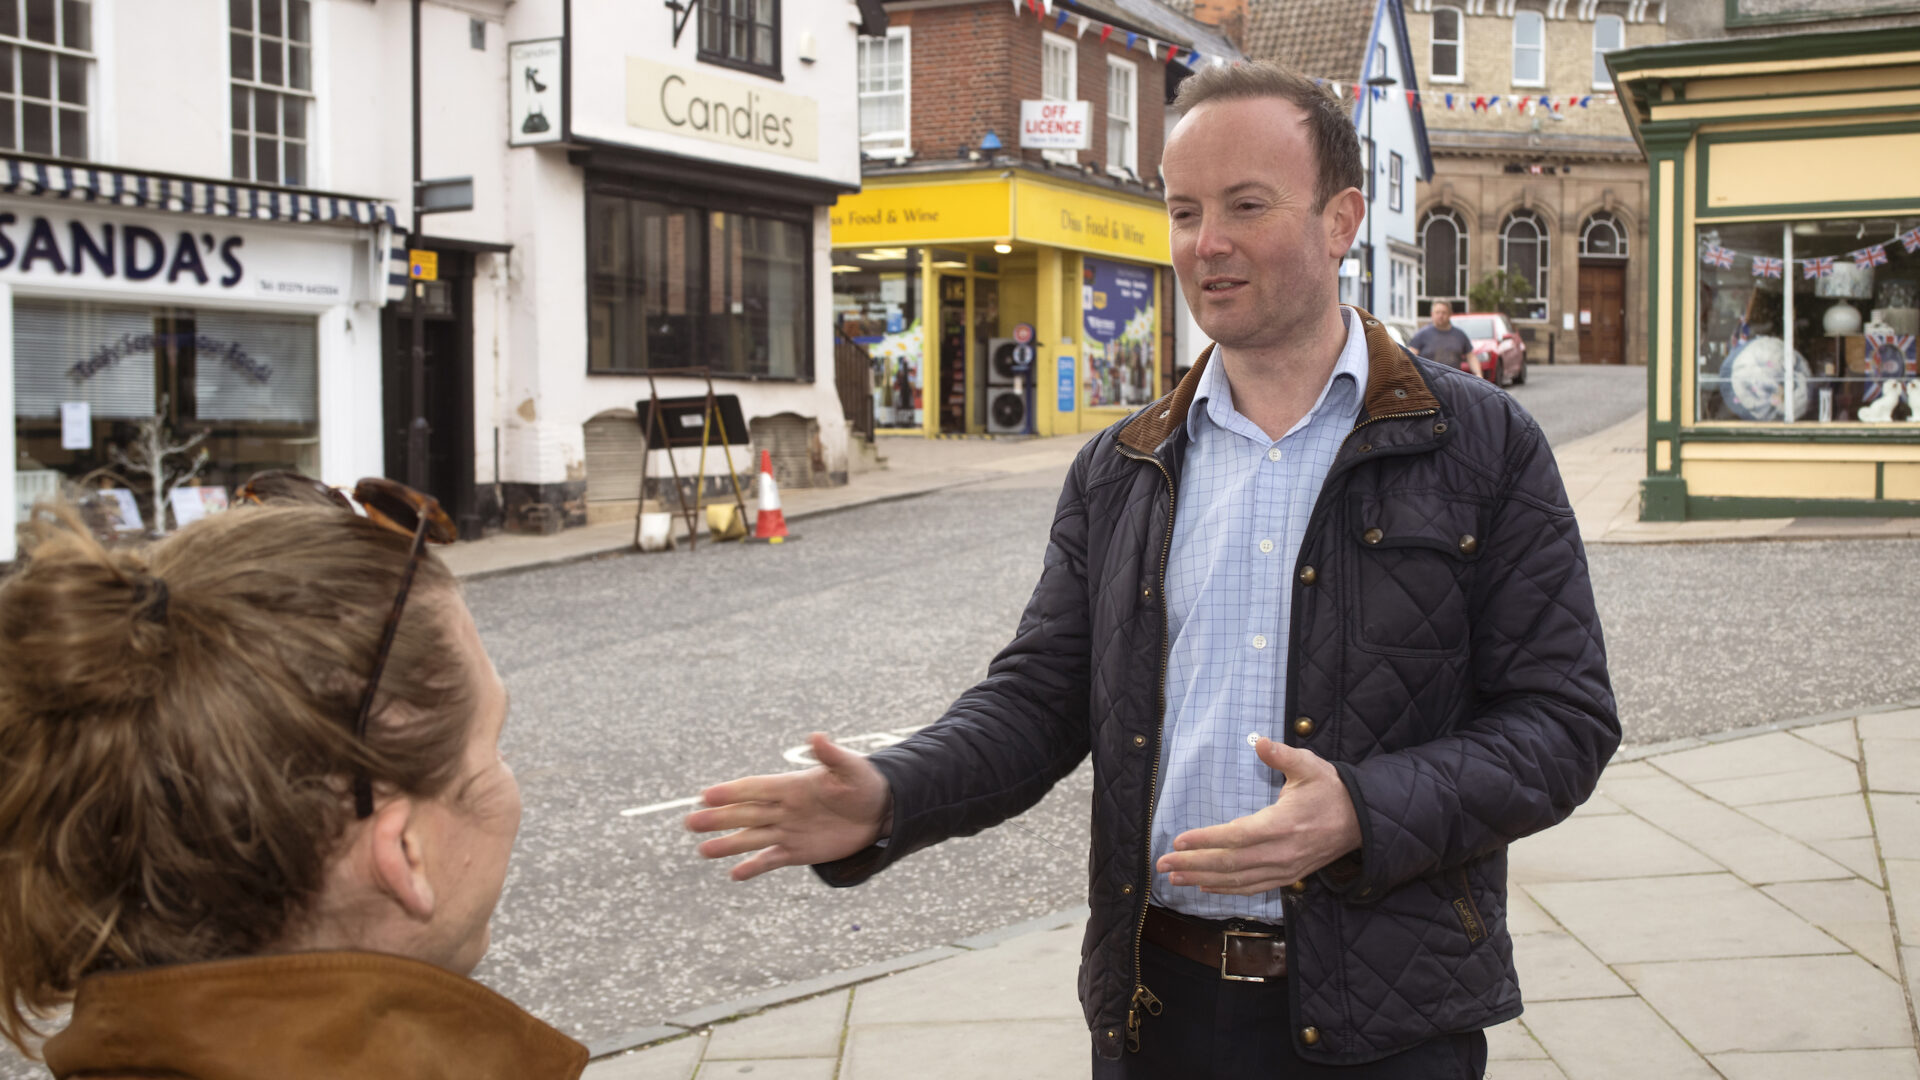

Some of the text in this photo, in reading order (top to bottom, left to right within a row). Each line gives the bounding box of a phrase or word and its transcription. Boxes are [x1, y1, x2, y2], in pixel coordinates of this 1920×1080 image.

[660, 74, 793, 147] Candies
[1042, 105, 1067, 118] OFF
[1025, 120, 1081, 134] LICENCE
[849, 209, 882, 225] Food
[886, 210, 897, 224] &
[903, 208, 940, 223] Wine
[1086, 214, 1109, 238] Food
[1122, 223, 1145, 245] Wine
